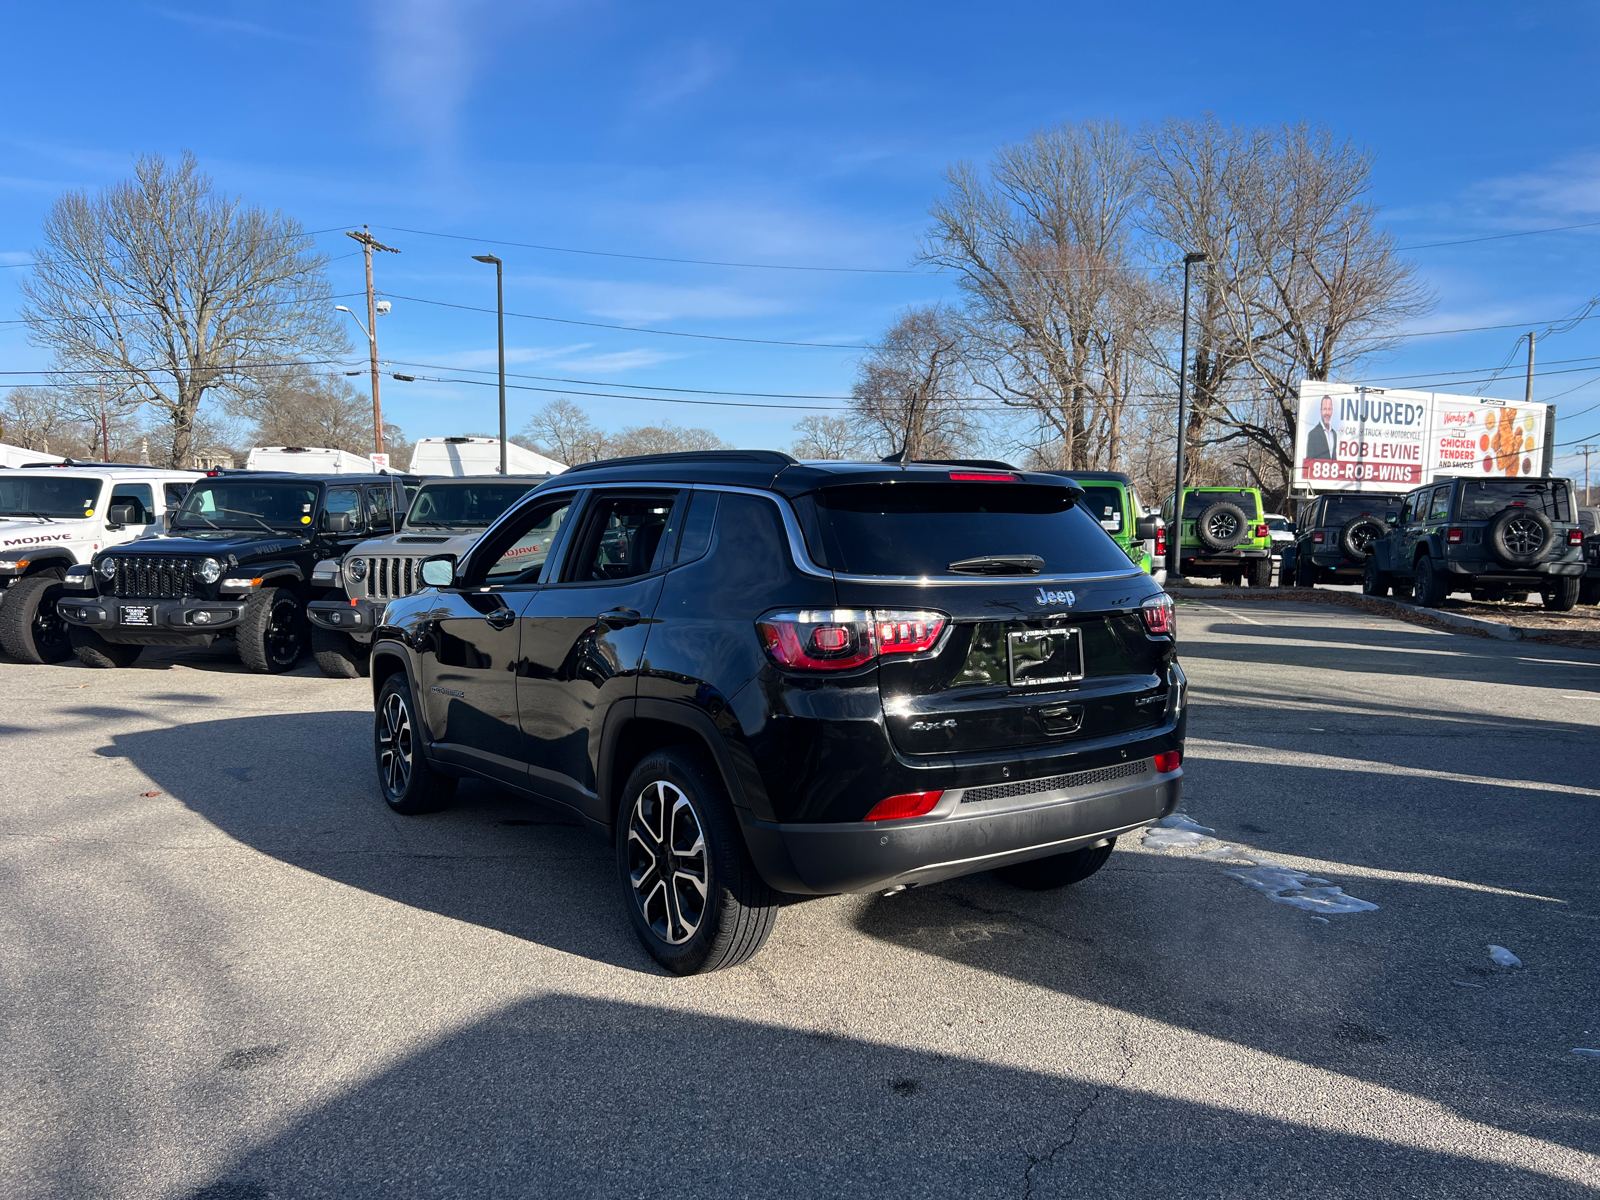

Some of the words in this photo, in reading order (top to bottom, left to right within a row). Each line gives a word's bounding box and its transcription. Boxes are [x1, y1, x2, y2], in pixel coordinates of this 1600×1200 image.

[1340, 398, 1424, 427] INJURED?
[1444, 411, 1467, 426] Wendy's
[1345, 427, 1356, 436] CAR
[1365, 428, 1382, 437] TRUCK
[1390, 430, 1421, 440] MOTORCYCLE
[1339, 441, 1369, 458] ROB
[1373, 443, 1420, 460] LEVINE
[1440, 438, 1476, 449] CHICKEN
[1440, 449, 1475, 460] TENDERS
[1312, 461, 1412, 481] 888-ROB-WINS
[1452, 461, 1474, 469] SAUCES
[3, 533, 72, 546] MOJAVE
[1034, 586, 1076, 608] Jeep
